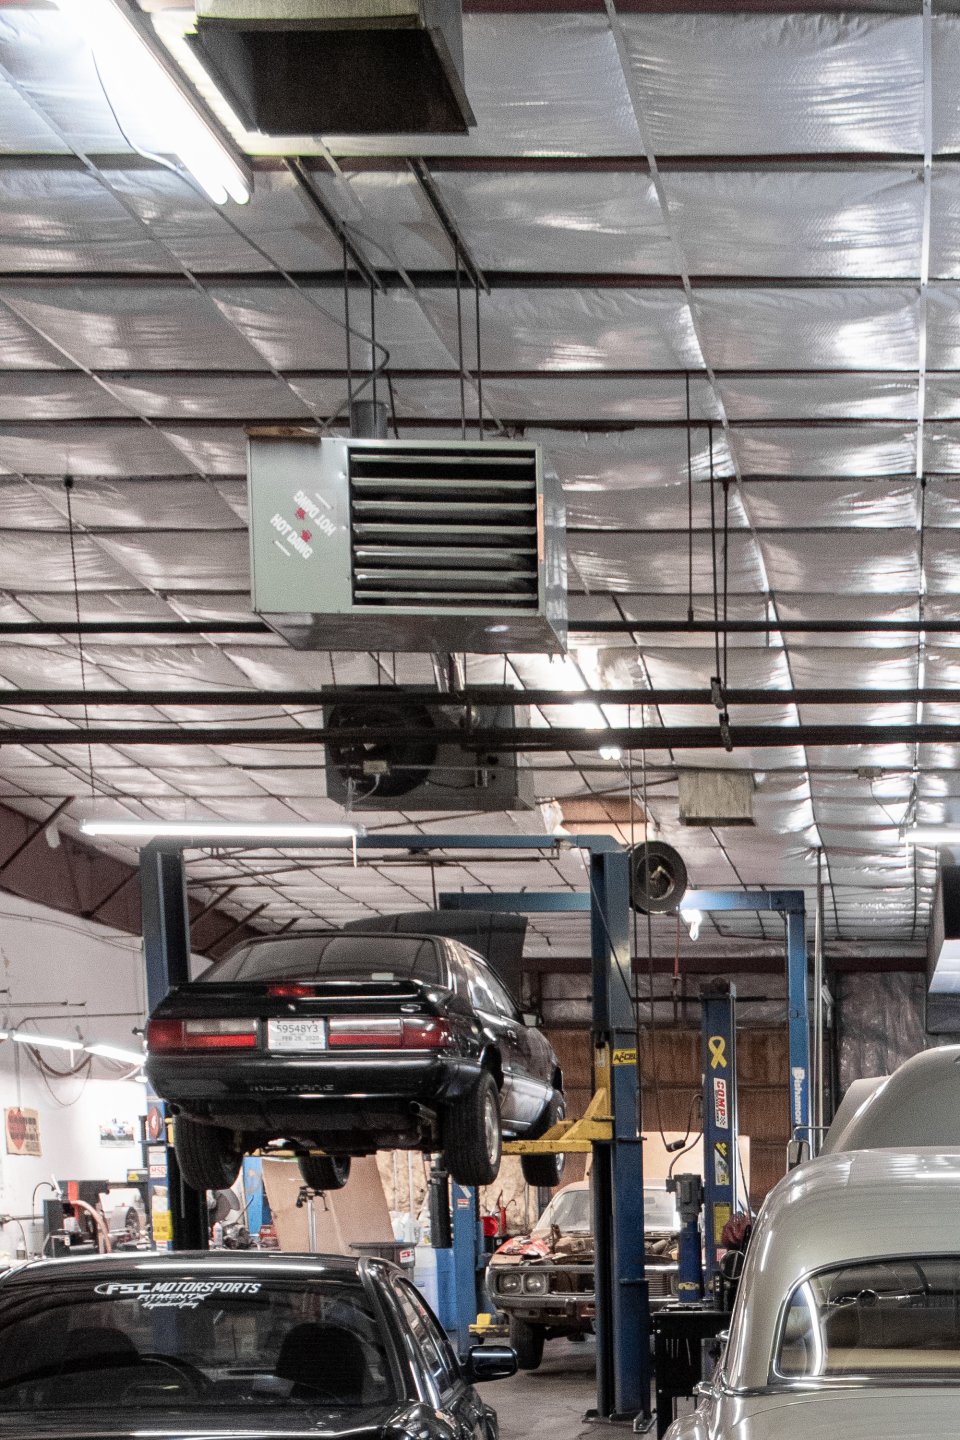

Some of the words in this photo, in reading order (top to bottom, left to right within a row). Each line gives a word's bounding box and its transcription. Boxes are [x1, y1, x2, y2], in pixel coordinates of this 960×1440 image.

[270, 513, 293, 536] HOT
[313, 514, 337, 537] HOT
[716, 1081, 726, 1117] COMP
[792, 1067, 805, 1124] Bishamon
[151, 1282, 261, 1293] MOTORSPORTS
